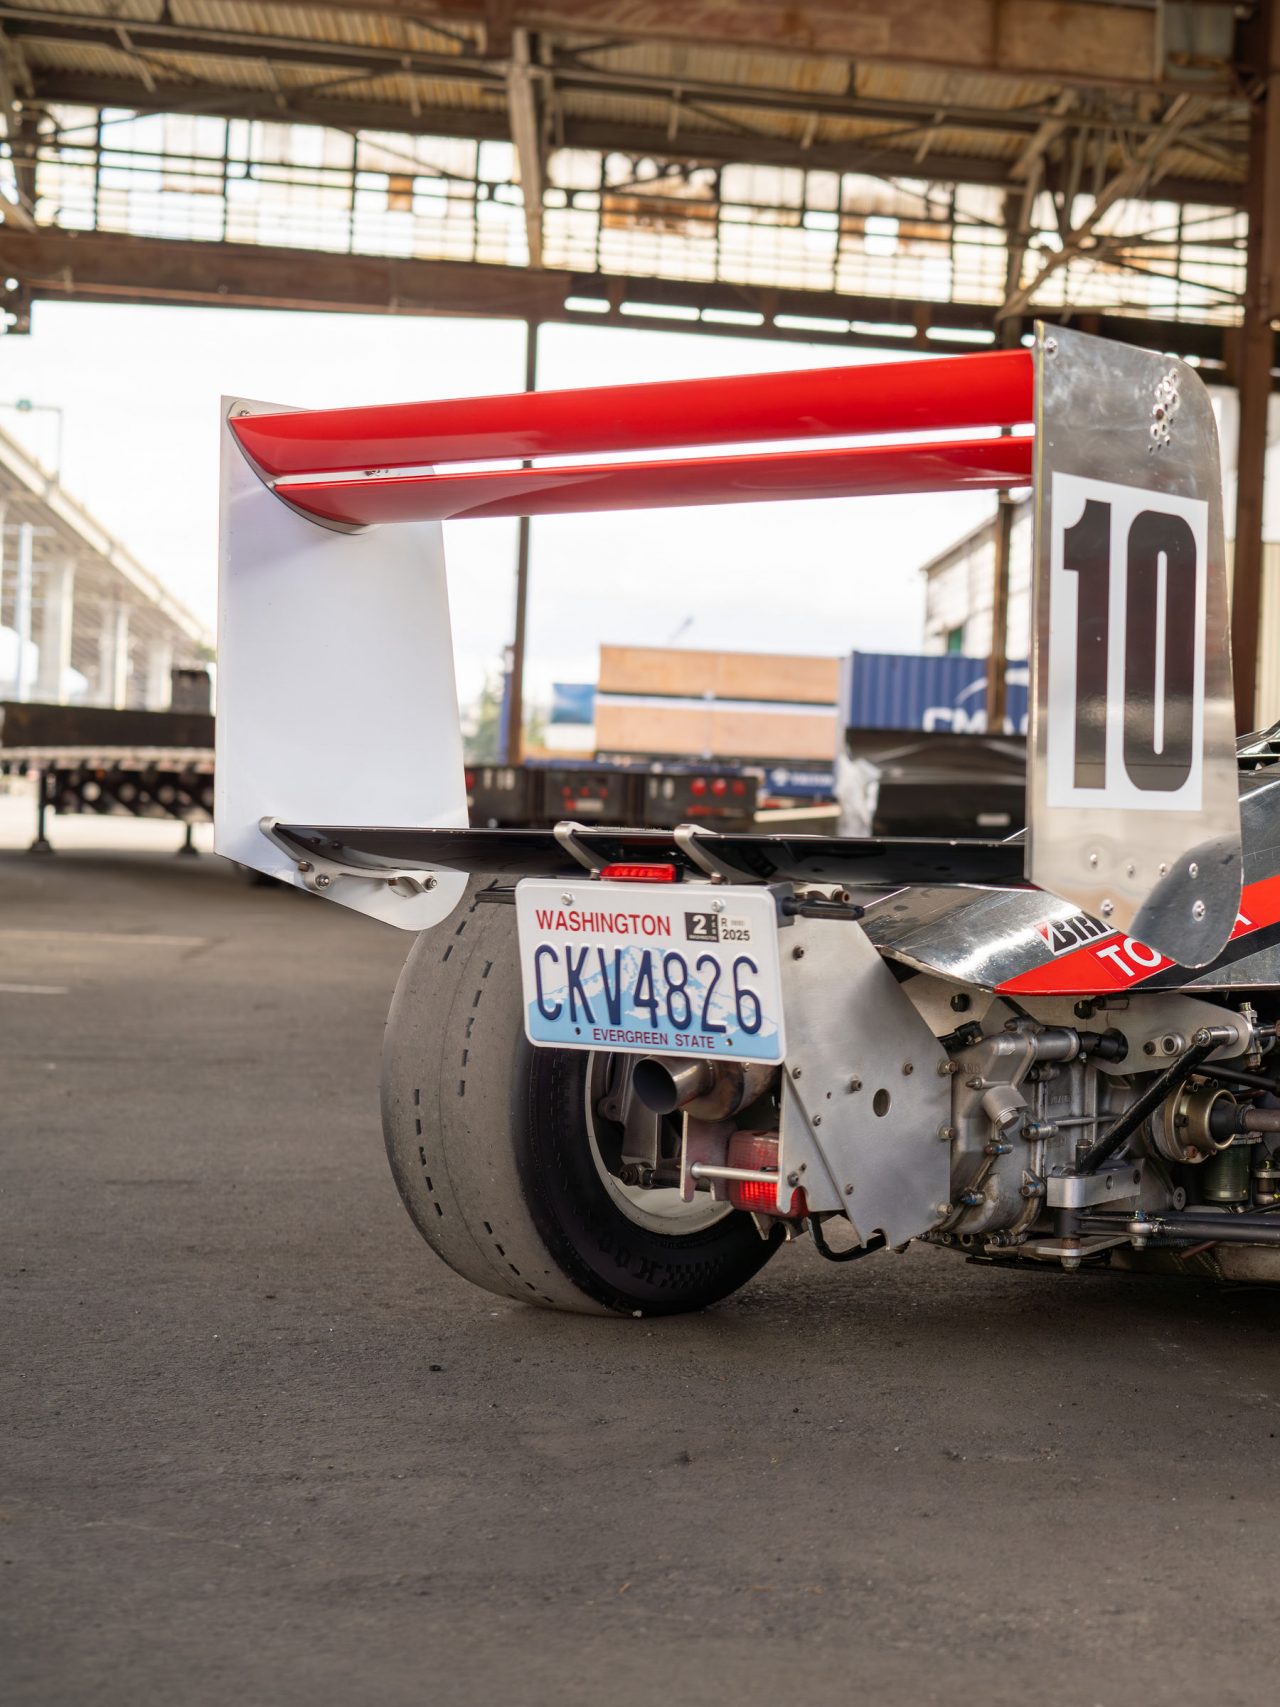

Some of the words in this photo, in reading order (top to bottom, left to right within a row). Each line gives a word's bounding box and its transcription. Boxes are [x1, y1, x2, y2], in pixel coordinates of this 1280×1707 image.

[1063, 498, 1197, 792] 10
[535, 909, 671, 936] WASHINGTON
[692, 914, 708, 935] 2
[722, 929, 750, 941] 2025
[534, 944, 762, 1035] CKV4826
[592, 1028, 669, 1046] EVERGREEN
[675, 1034, 716, 1049] STATE
